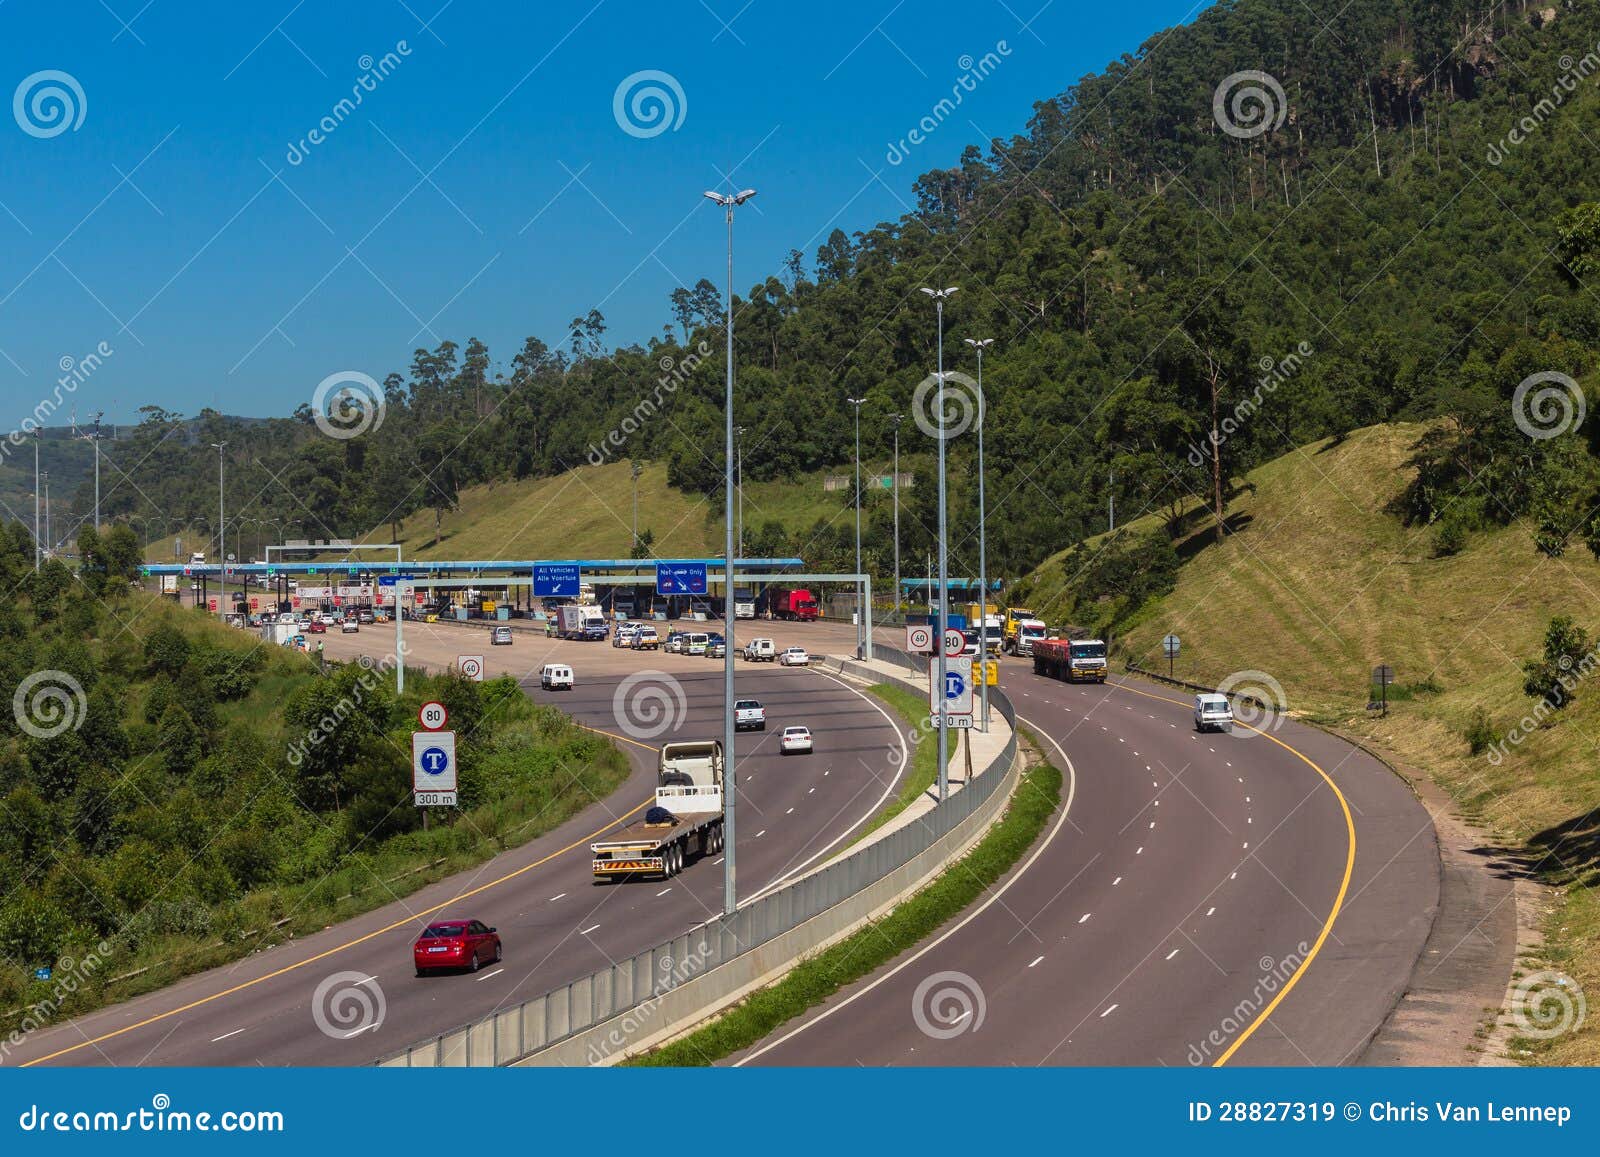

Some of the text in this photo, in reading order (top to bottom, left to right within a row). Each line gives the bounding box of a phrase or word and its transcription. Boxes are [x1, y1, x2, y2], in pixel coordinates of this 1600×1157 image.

[539, 567, 575, 575] All Vehicles
[689, 569, 703, 577] Only
[915, 634, 925, 642] 60
[945, 636, 959, 648] 80
[466, 665, 476, 673] 60
[426, 710, 441, 722] 80
[935, 716, 968, 726] 30 m
[426, 752, 442, 770] T
[419, 794, 453, 805] 300 m
